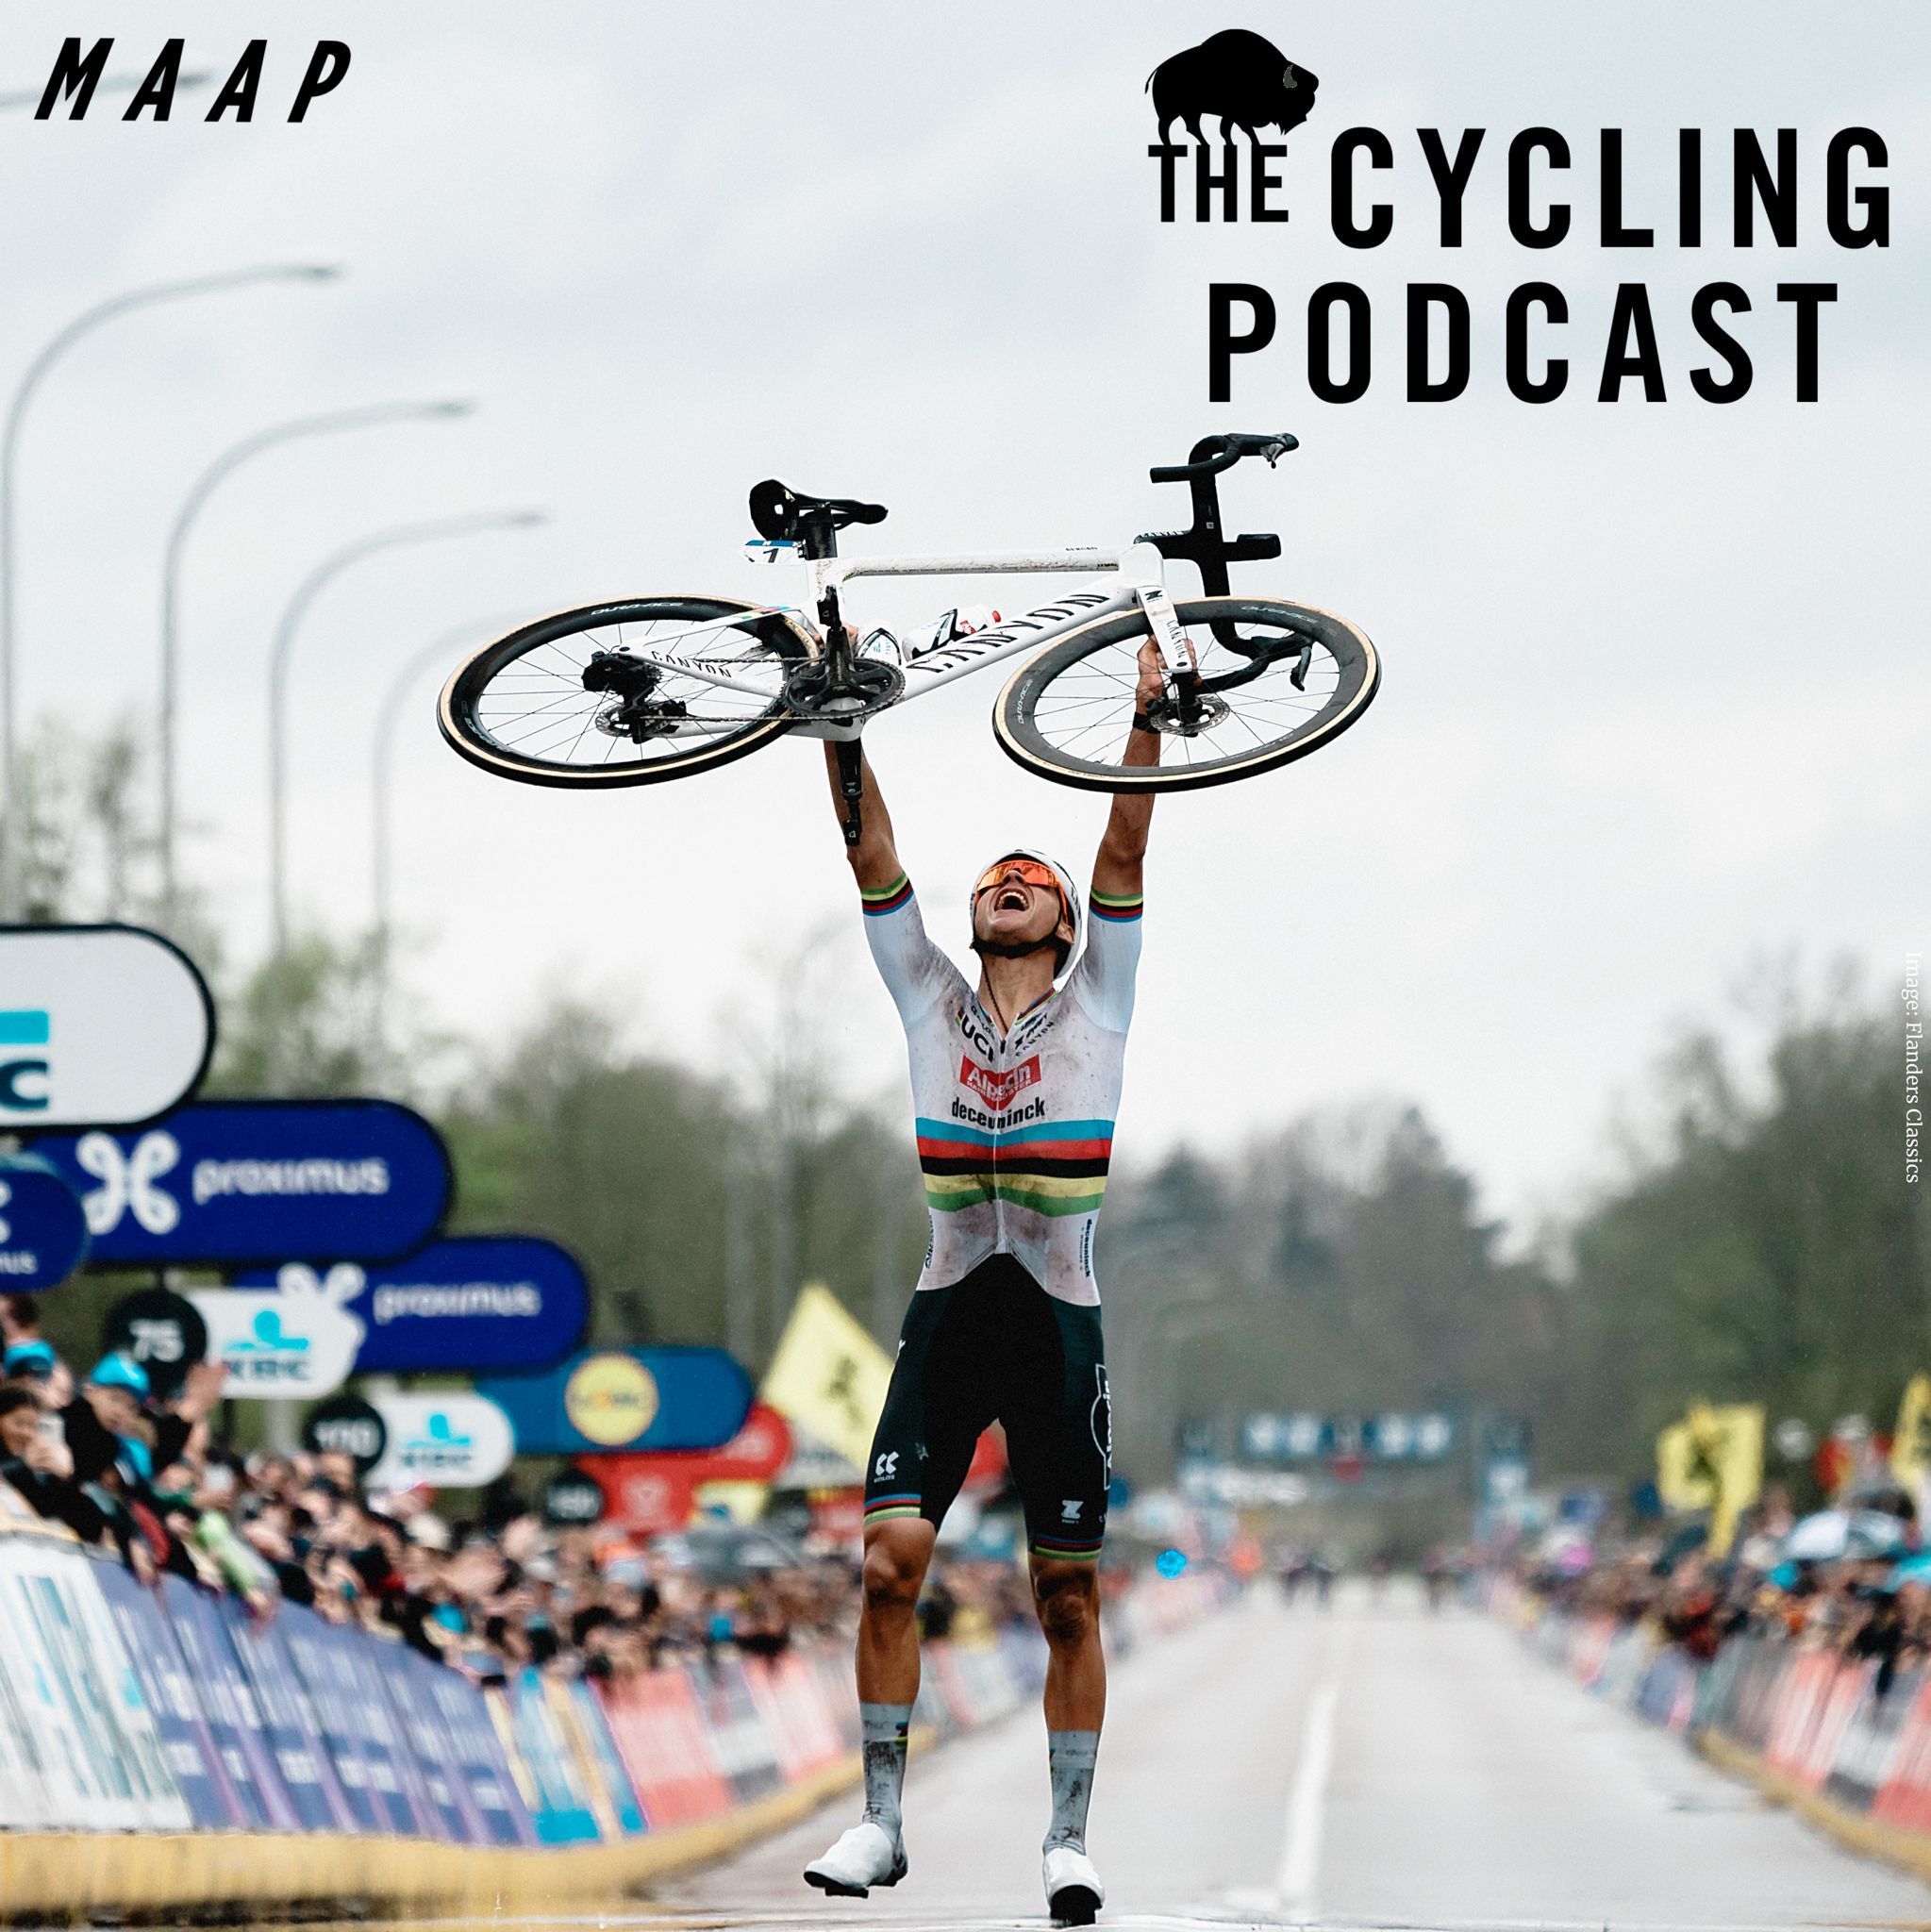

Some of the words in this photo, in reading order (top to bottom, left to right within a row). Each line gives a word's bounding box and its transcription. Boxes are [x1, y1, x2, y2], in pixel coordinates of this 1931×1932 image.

[762, 547, 780, 564] 1
[905, 593, 1111, 674] CANYON
[651, 650, 733, 679] CANYON
[961, 1013, 995, 1063] UCI
[966, 1065, 1032, 1101] Alpecin
[951, 1096, 1045, 1130] deceuninck
[191, 1159, 390, 1205] proximus
[373, 1284, 541, 1325] proximus
[129, 1320, 185, 1361] 75
